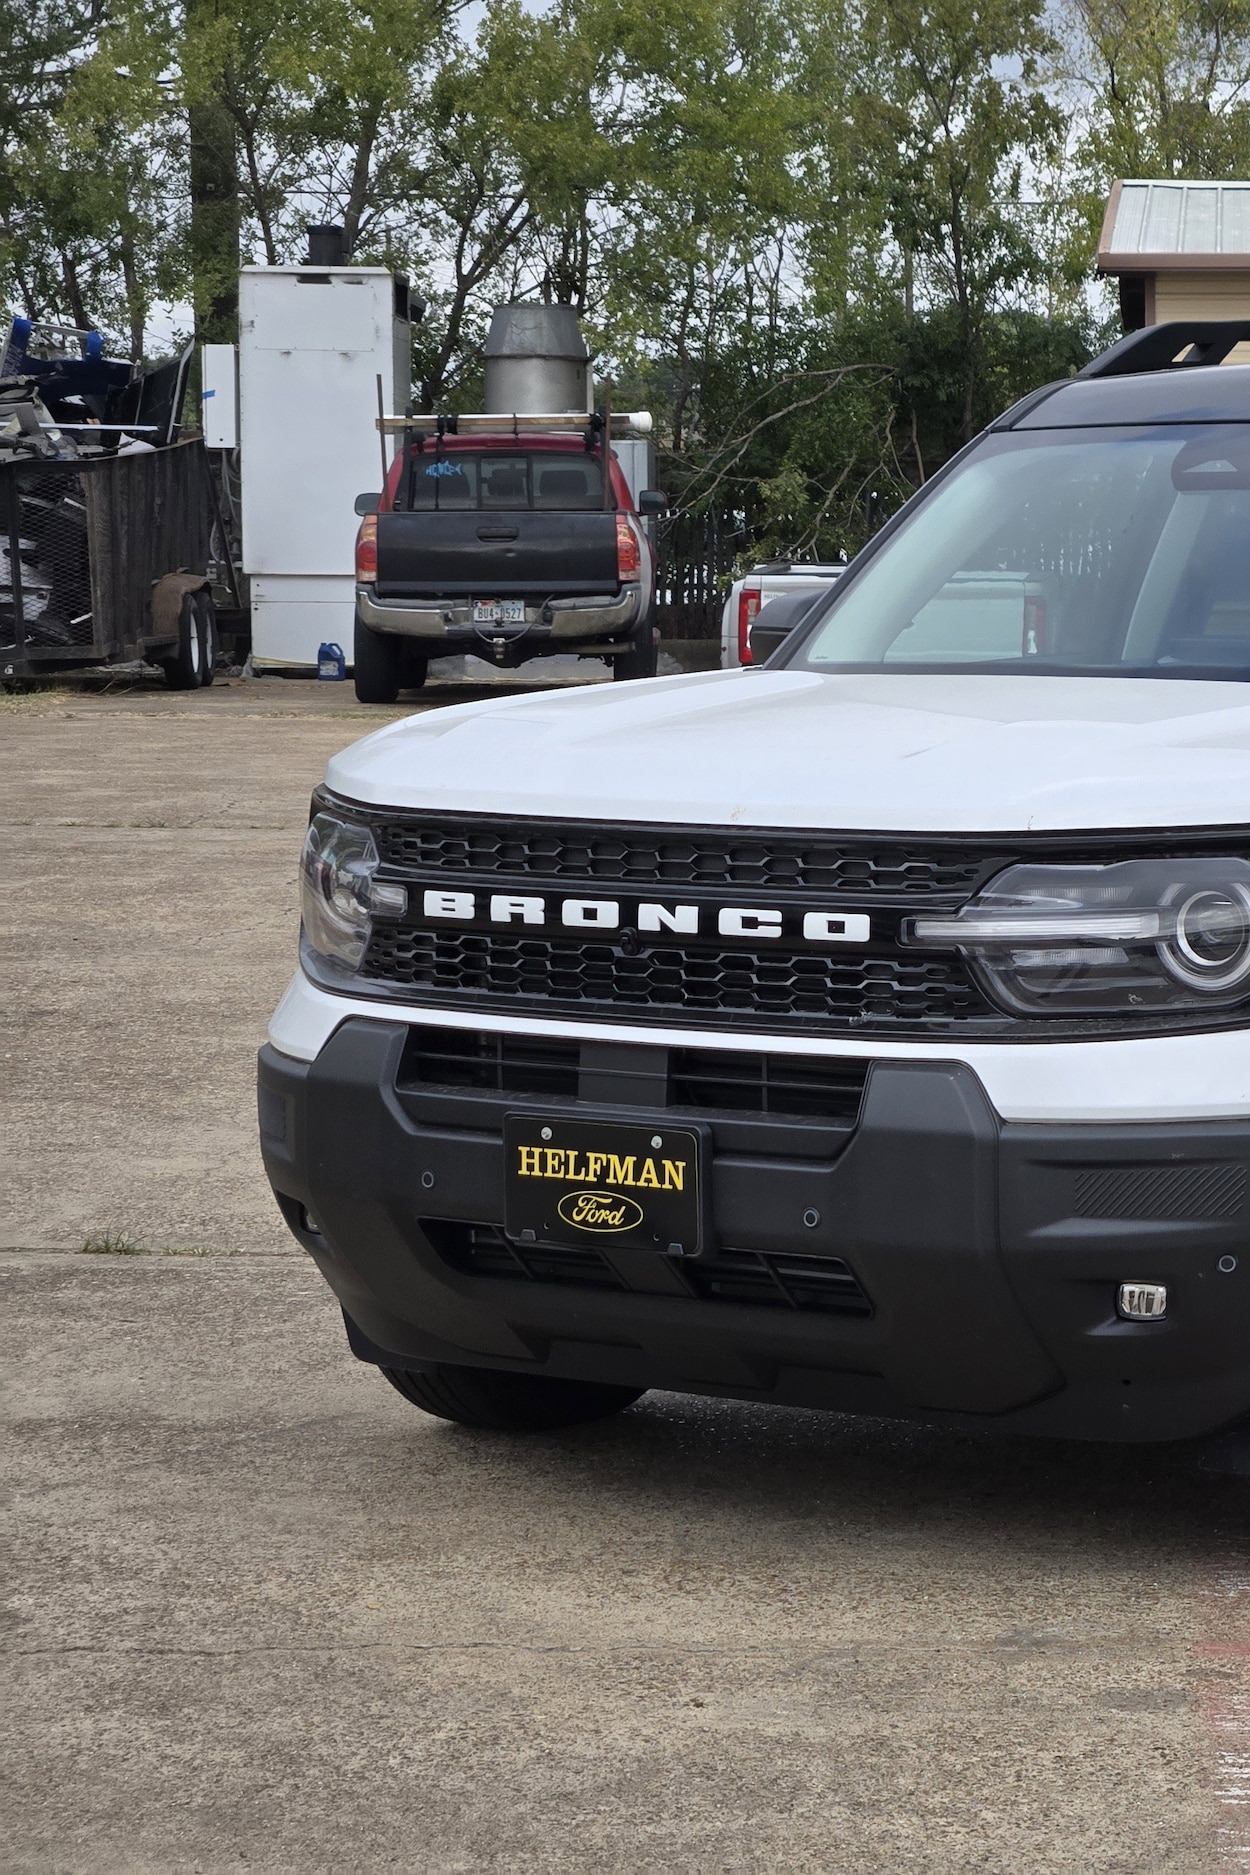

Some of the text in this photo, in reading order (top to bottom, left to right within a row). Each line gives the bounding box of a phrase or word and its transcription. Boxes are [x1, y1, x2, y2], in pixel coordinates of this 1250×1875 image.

[423, 889, 871, 942] BRONCO
[517, 1145, 686, 1191] HELFMAN
[572, 1194, 626, 1226] Ford
